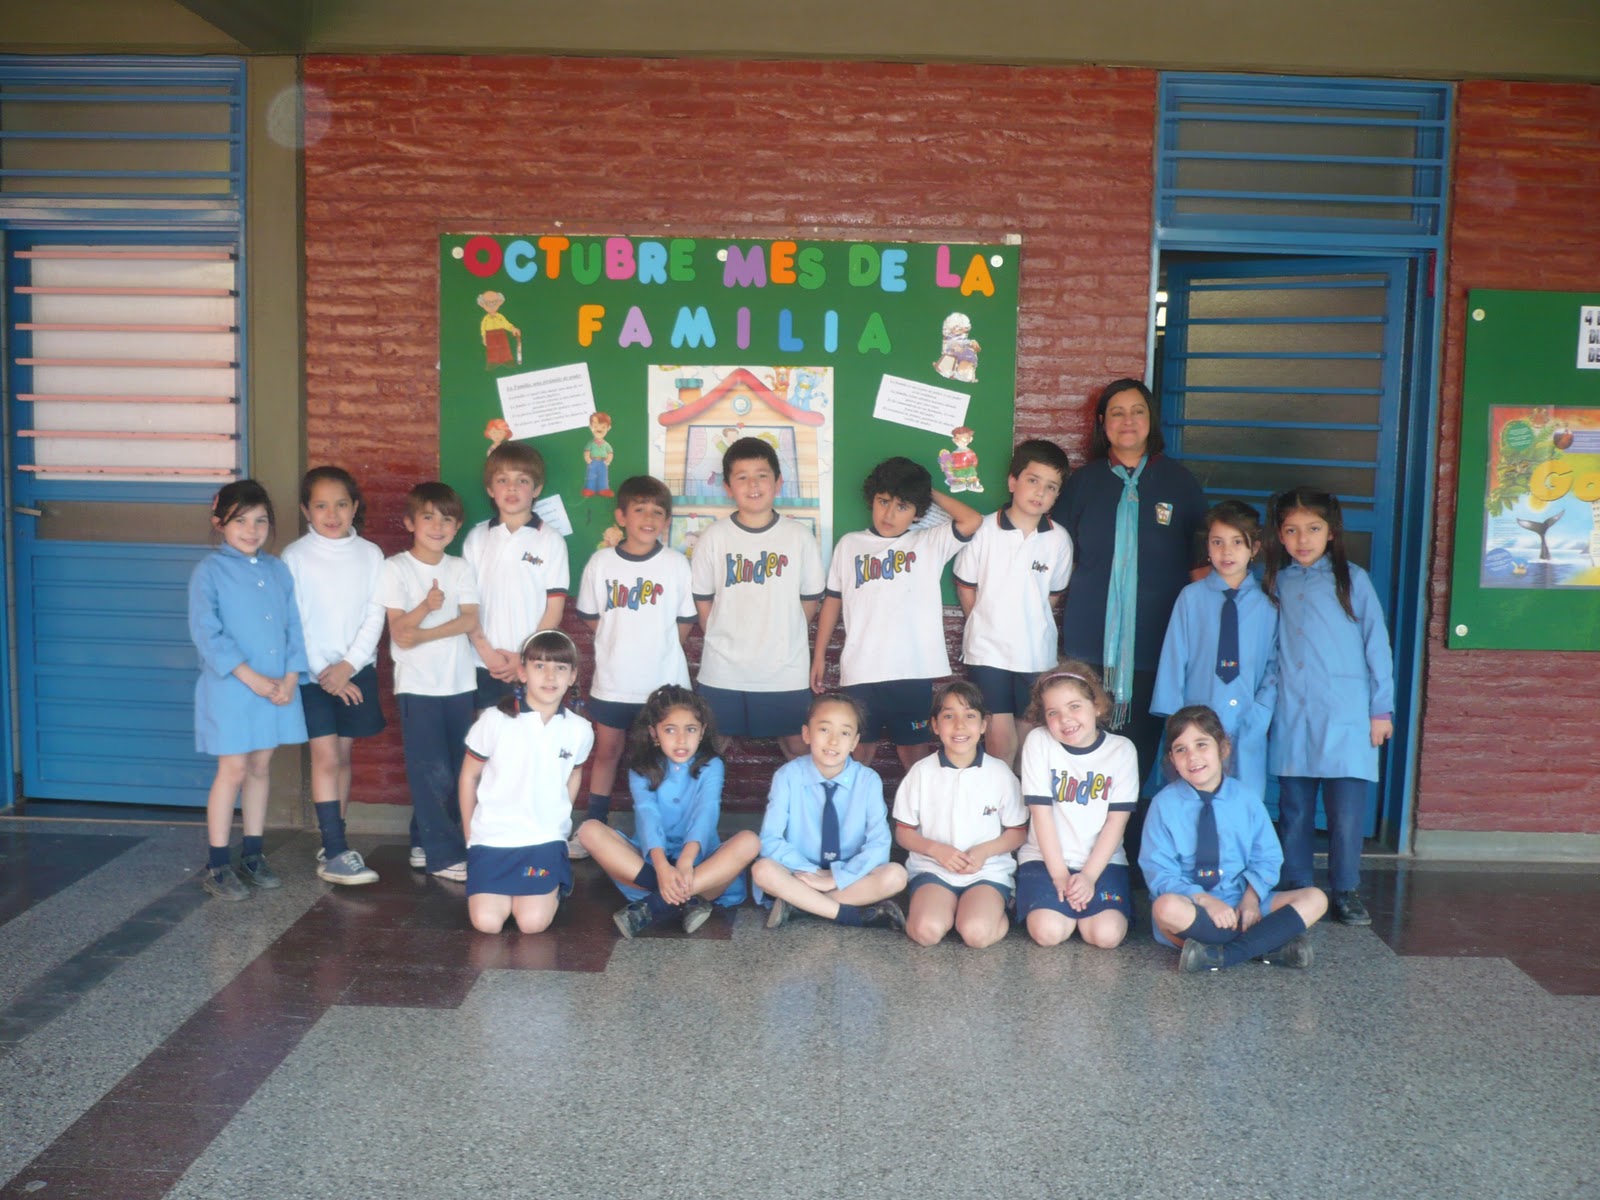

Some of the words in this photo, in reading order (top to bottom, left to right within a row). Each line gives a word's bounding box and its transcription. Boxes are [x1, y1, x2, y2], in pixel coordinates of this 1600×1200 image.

[462, 236, 696, 284] OCTUBRE
[723, 241, 826, 289] MES
[848, 245, 907, 292] DE
[936, 245, 995, 297] LA
[577, 304, 892, 354] FAMILIA
[725, 551, 788, 587] kinder
[855, 549, 916, 588] kinder
[605, 577, 664, 612] kinder
[1050, 769, 1112, 805] kinder
